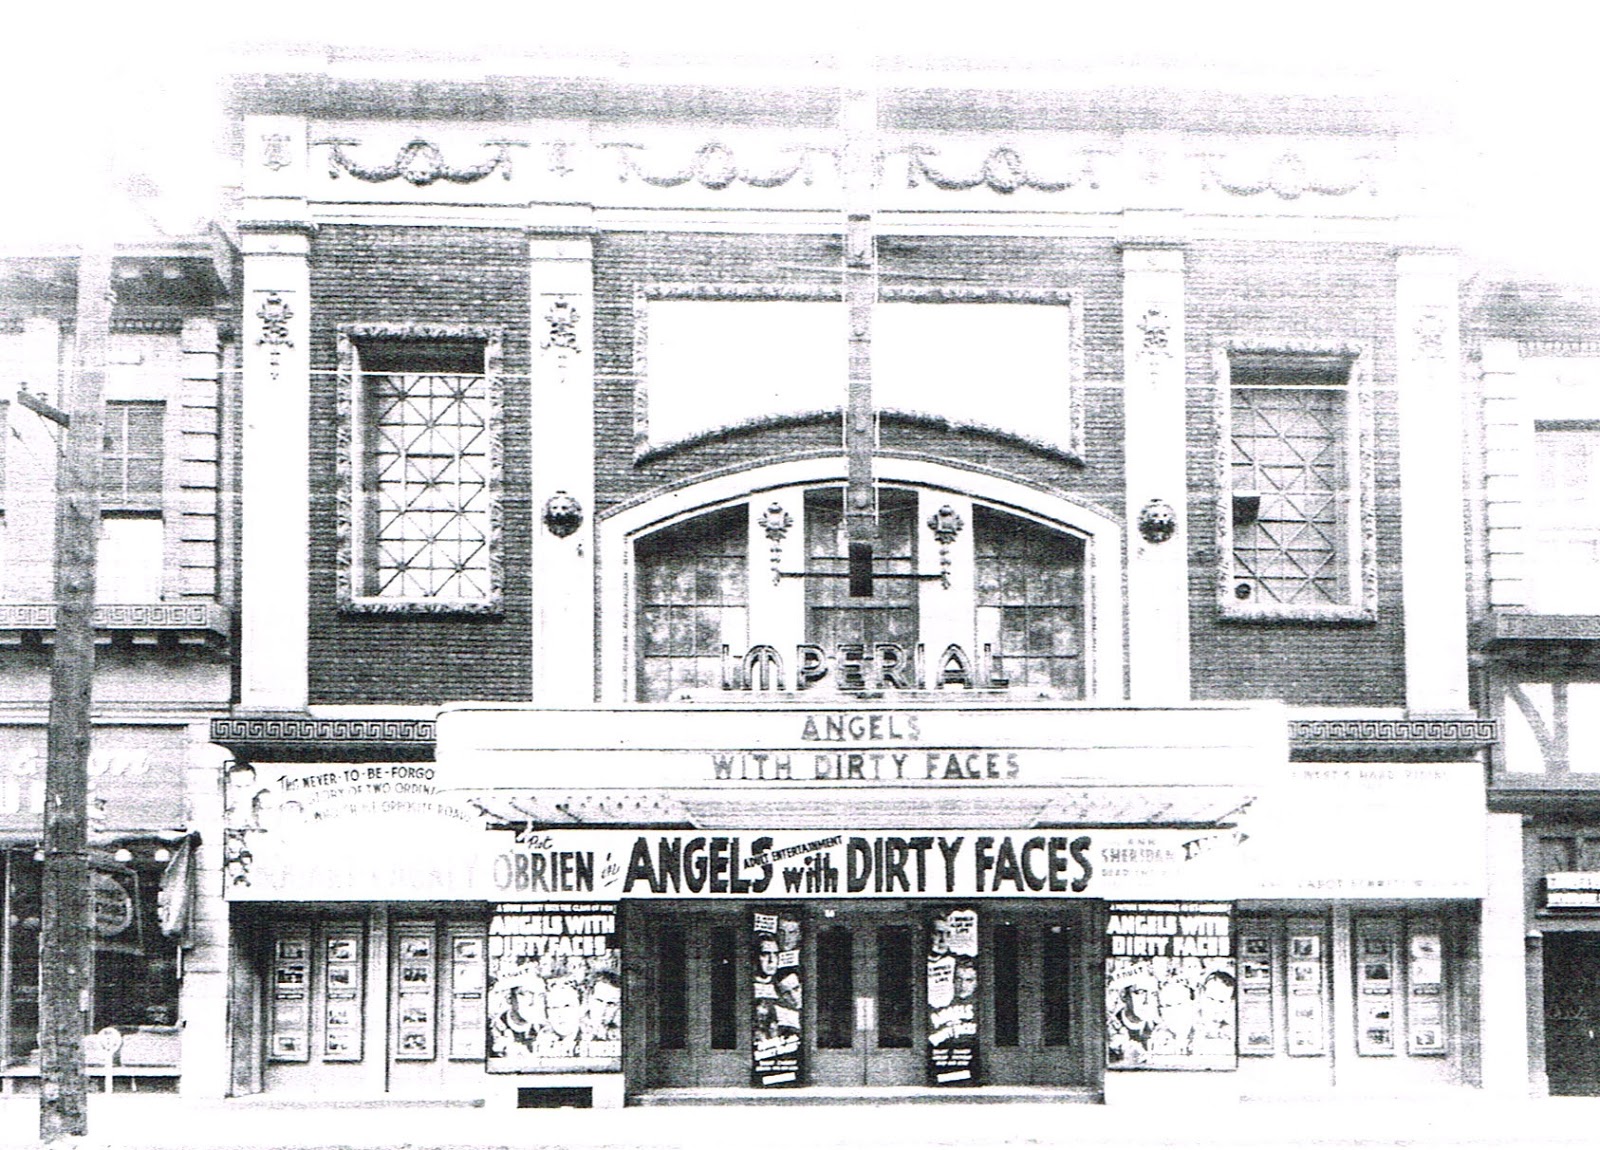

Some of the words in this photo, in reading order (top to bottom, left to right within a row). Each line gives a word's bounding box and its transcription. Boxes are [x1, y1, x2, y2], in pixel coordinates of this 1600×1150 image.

[721, 643, 1010, 691] IMPERIAL
[801, 714, 921, 741] ANGELS
[713, 753, 792, 779] WITH
[815, 753, 907, 779] DIRTY
[926, 753, 1019, 779] FACES
[527, 835, 553, 849] Pat
[771, 835, 842, 862] ENTERTAINMENT
[622, 836, 774, 894] ANGELS
[782, 851, 839, 894] with
[847, 836, 965, 893] DIRTY
[975, 836, 1094, 893] FACES
[488, 915, 563, 936] ANGELS
[564, 915, 615, 935] WITH
[1106, 915, 1178, 935] ANGELS
[1112, 936, 1169, 956] DIRTY
